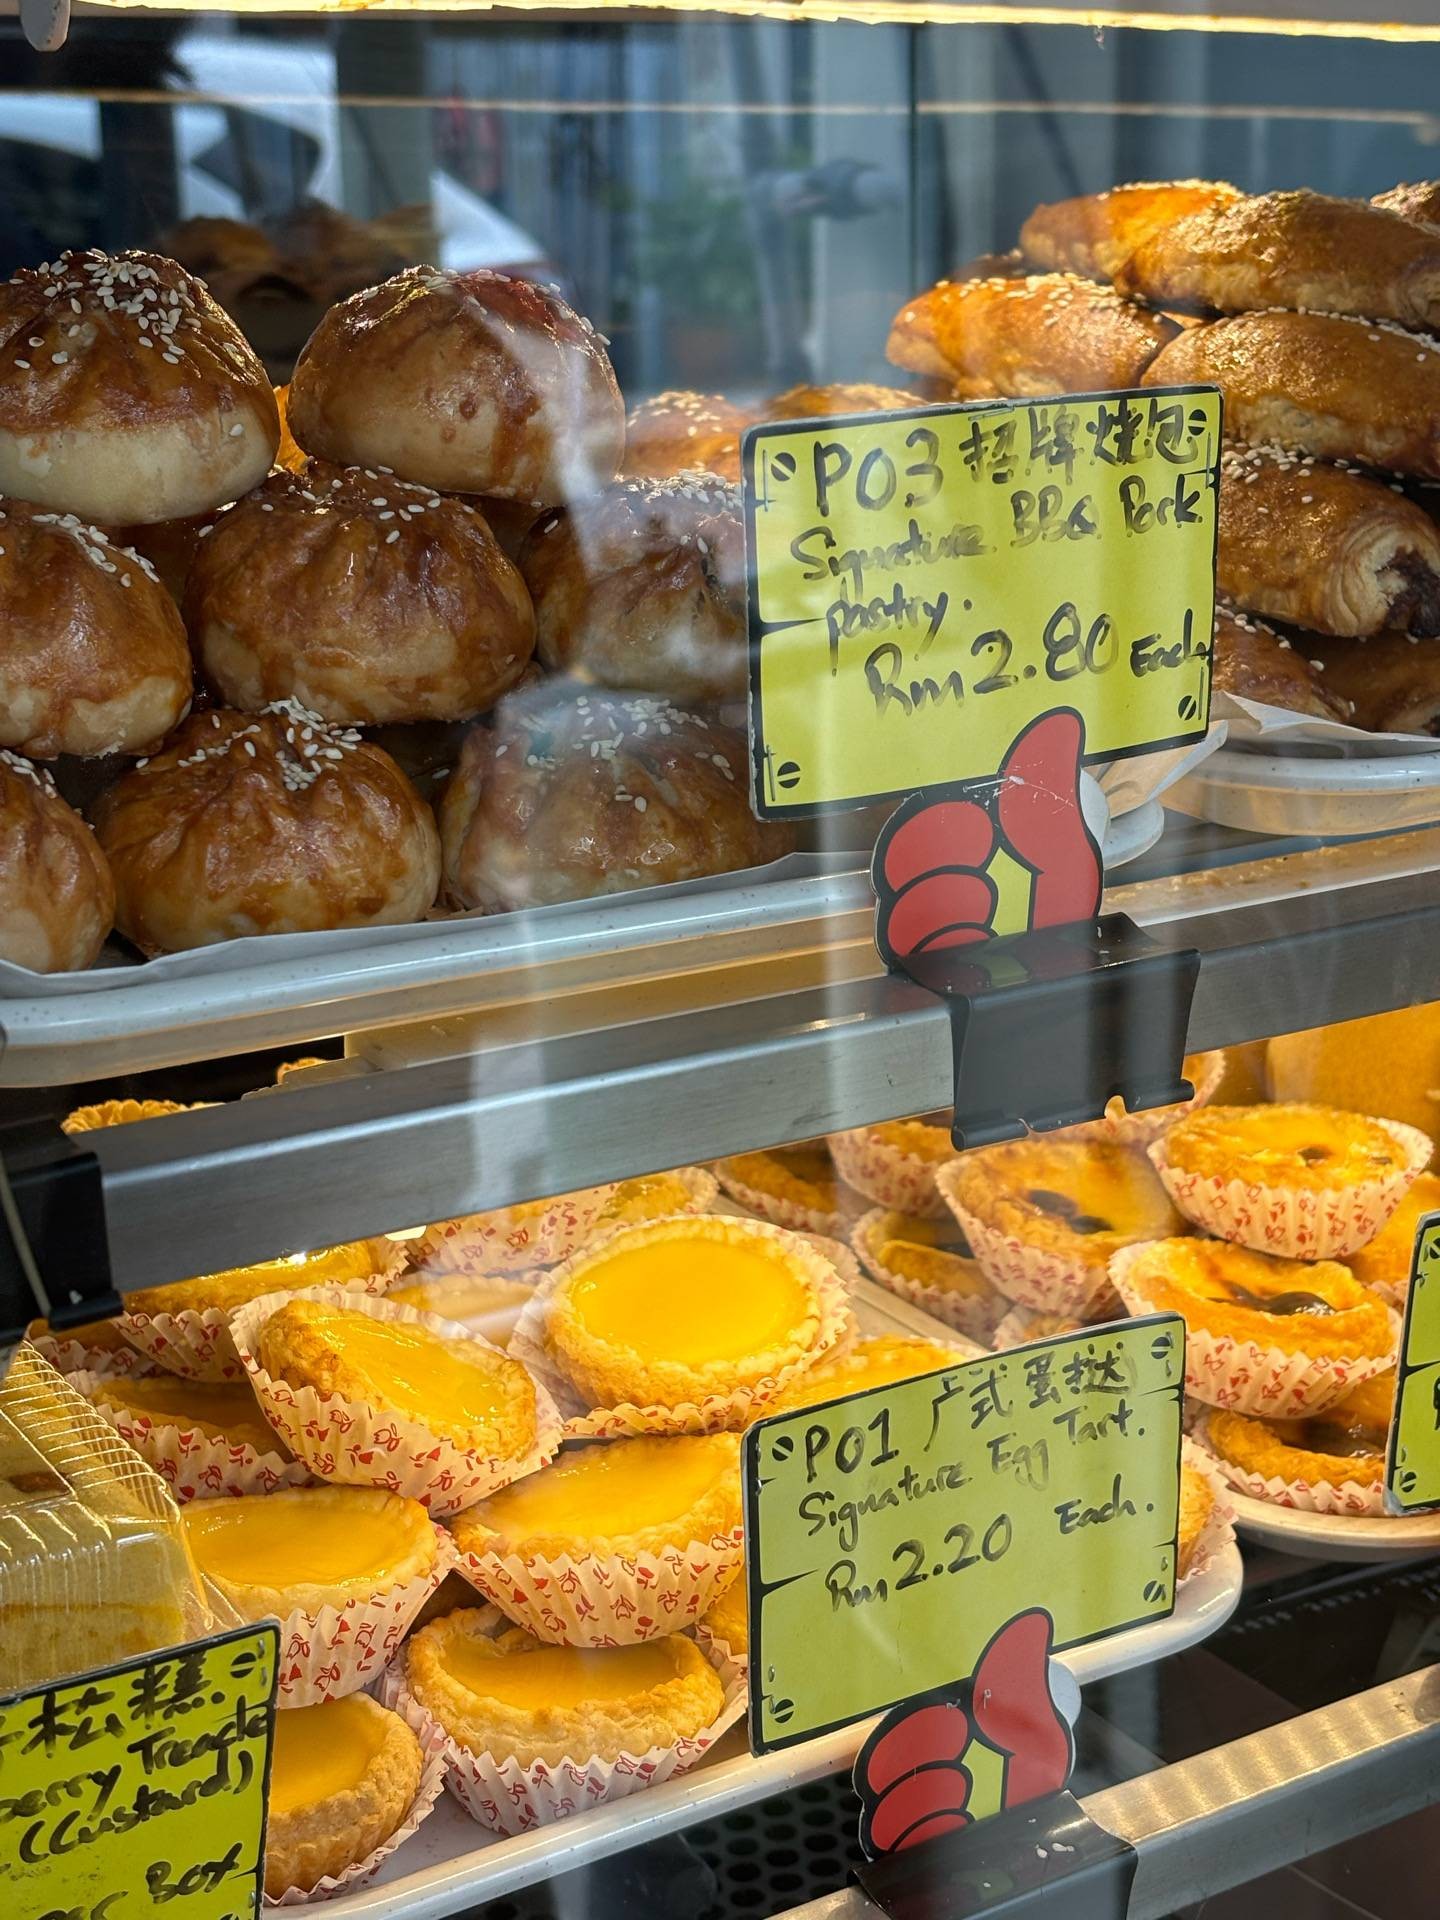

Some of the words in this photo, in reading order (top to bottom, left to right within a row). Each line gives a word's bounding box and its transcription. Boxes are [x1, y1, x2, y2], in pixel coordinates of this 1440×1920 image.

[814, 427, 944, 518] P03
[1119, 474, 1203, 538] Pork
[1130, 608, 1207, 678] Each
[804, 1408, 900, 1483] P01
[799, 1463, 973, 1552] Signature
[986, 1432, 1049, 1492] Egg
